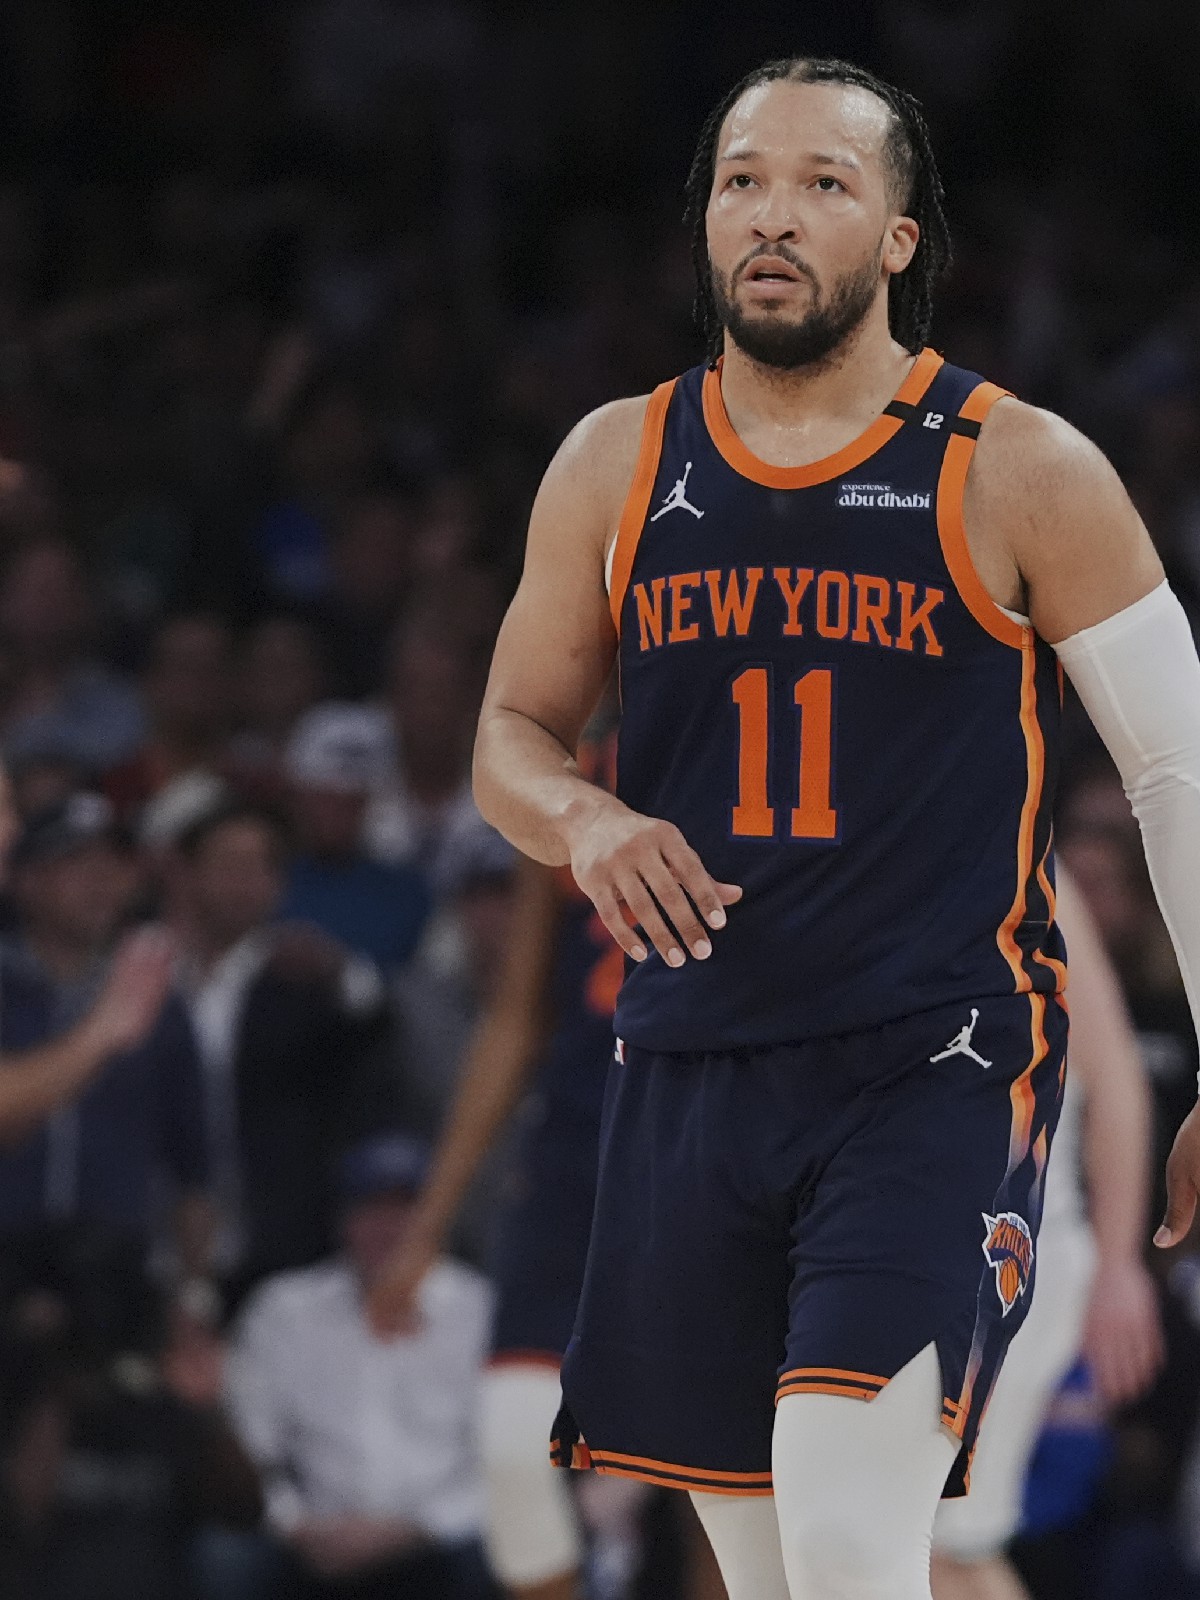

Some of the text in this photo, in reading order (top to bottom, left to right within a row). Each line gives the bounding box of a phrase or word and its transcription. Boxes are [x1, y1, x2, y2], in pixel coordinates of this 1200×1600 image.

[922, 411, 944, 430] 12
[841, 483, 891, 492] experience
[838, 491, 931, 509] abu dhabi
[633, 567, 945, 657] NEW YORK
[730, 666, 838, 840] 11
